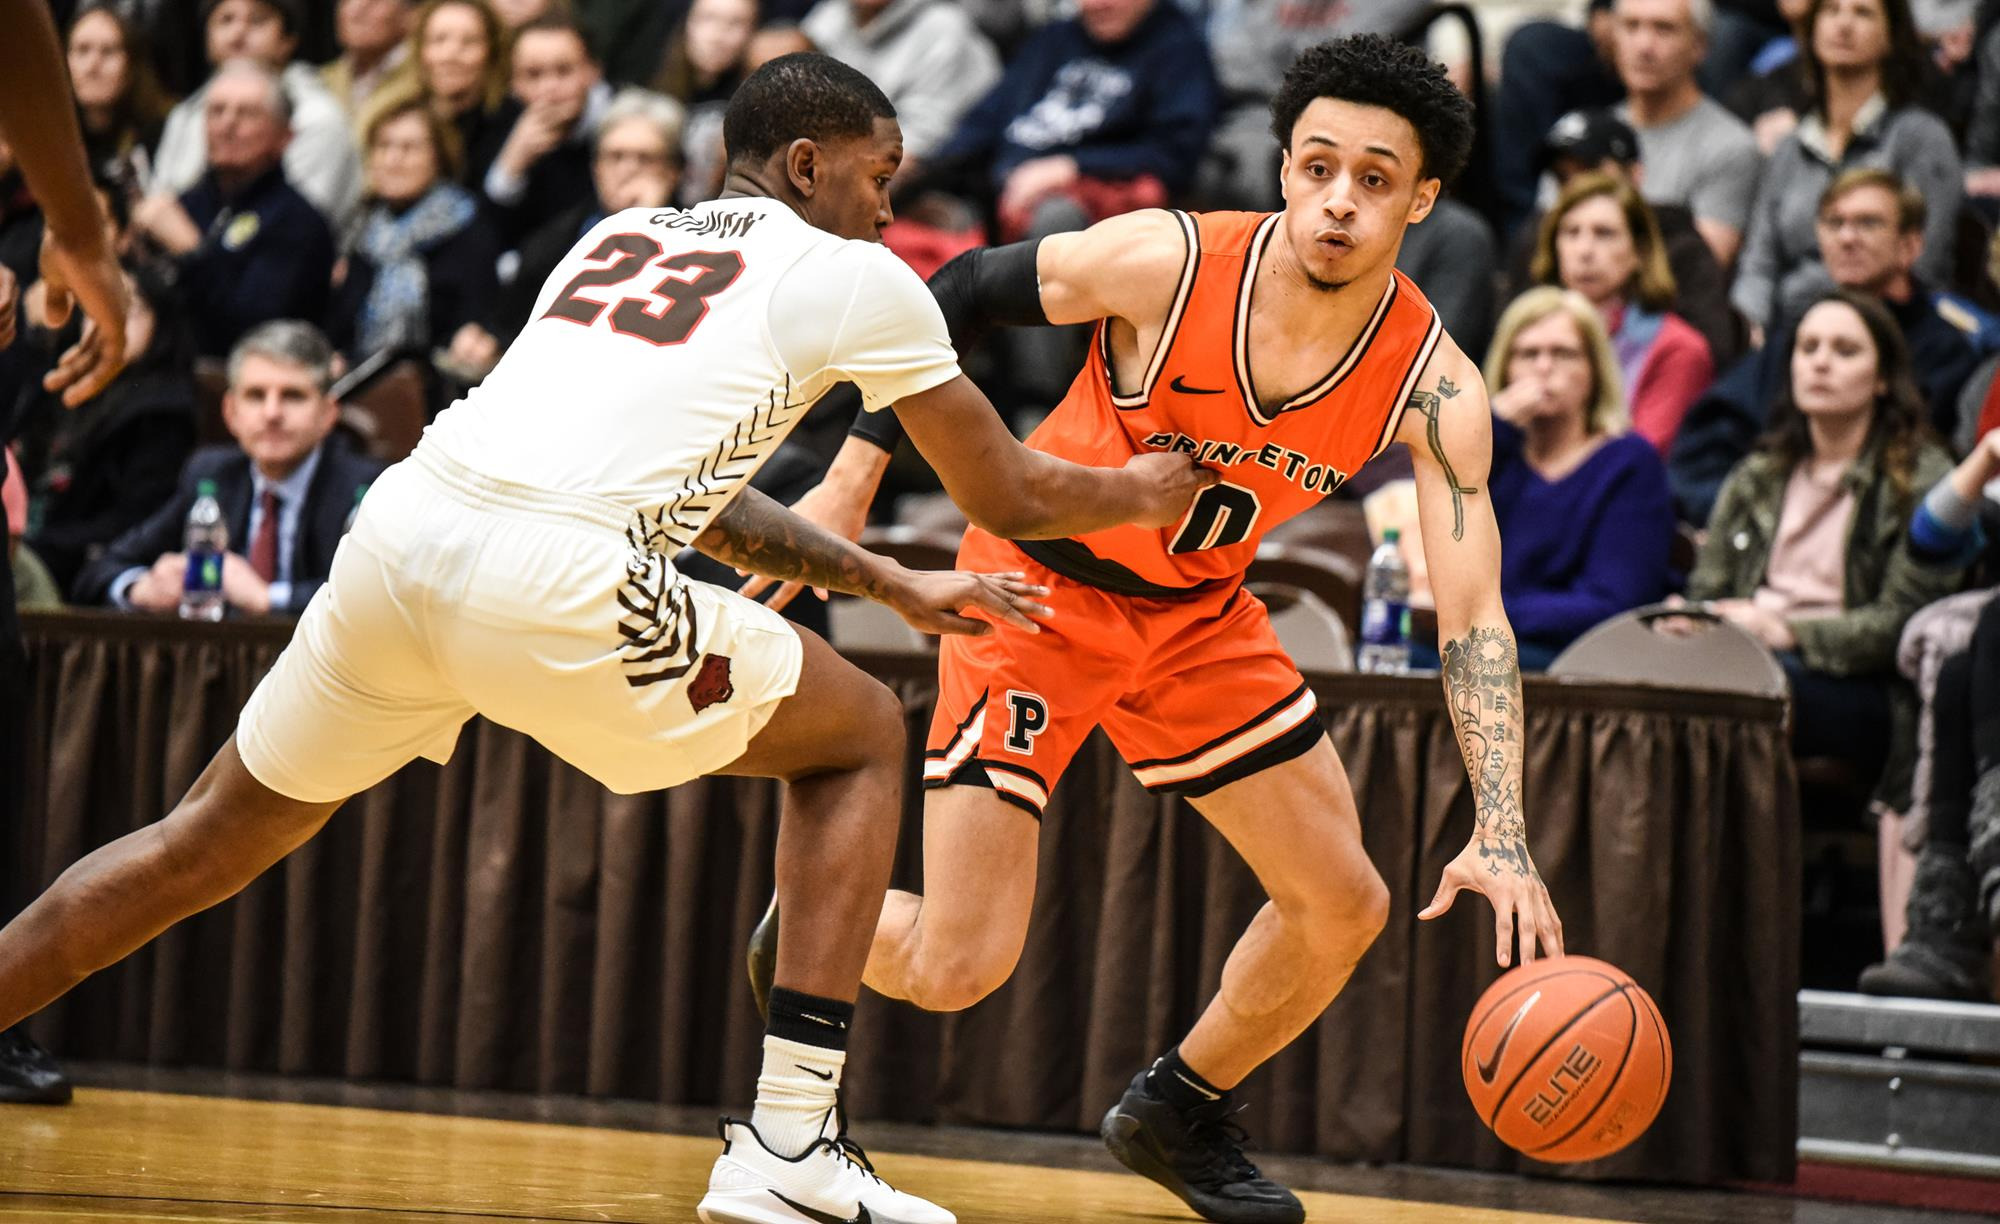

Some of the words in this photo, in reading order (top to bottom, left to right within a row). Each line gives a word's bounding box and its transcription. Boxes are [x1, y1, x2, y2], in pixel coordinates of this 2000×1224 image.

[537, 232, 746, 347] 23
[1168, 480, 1262, 555] 0
[1004, 689, 1049, 756] P
[1521, 1044, 1597, 1127] ELITE
